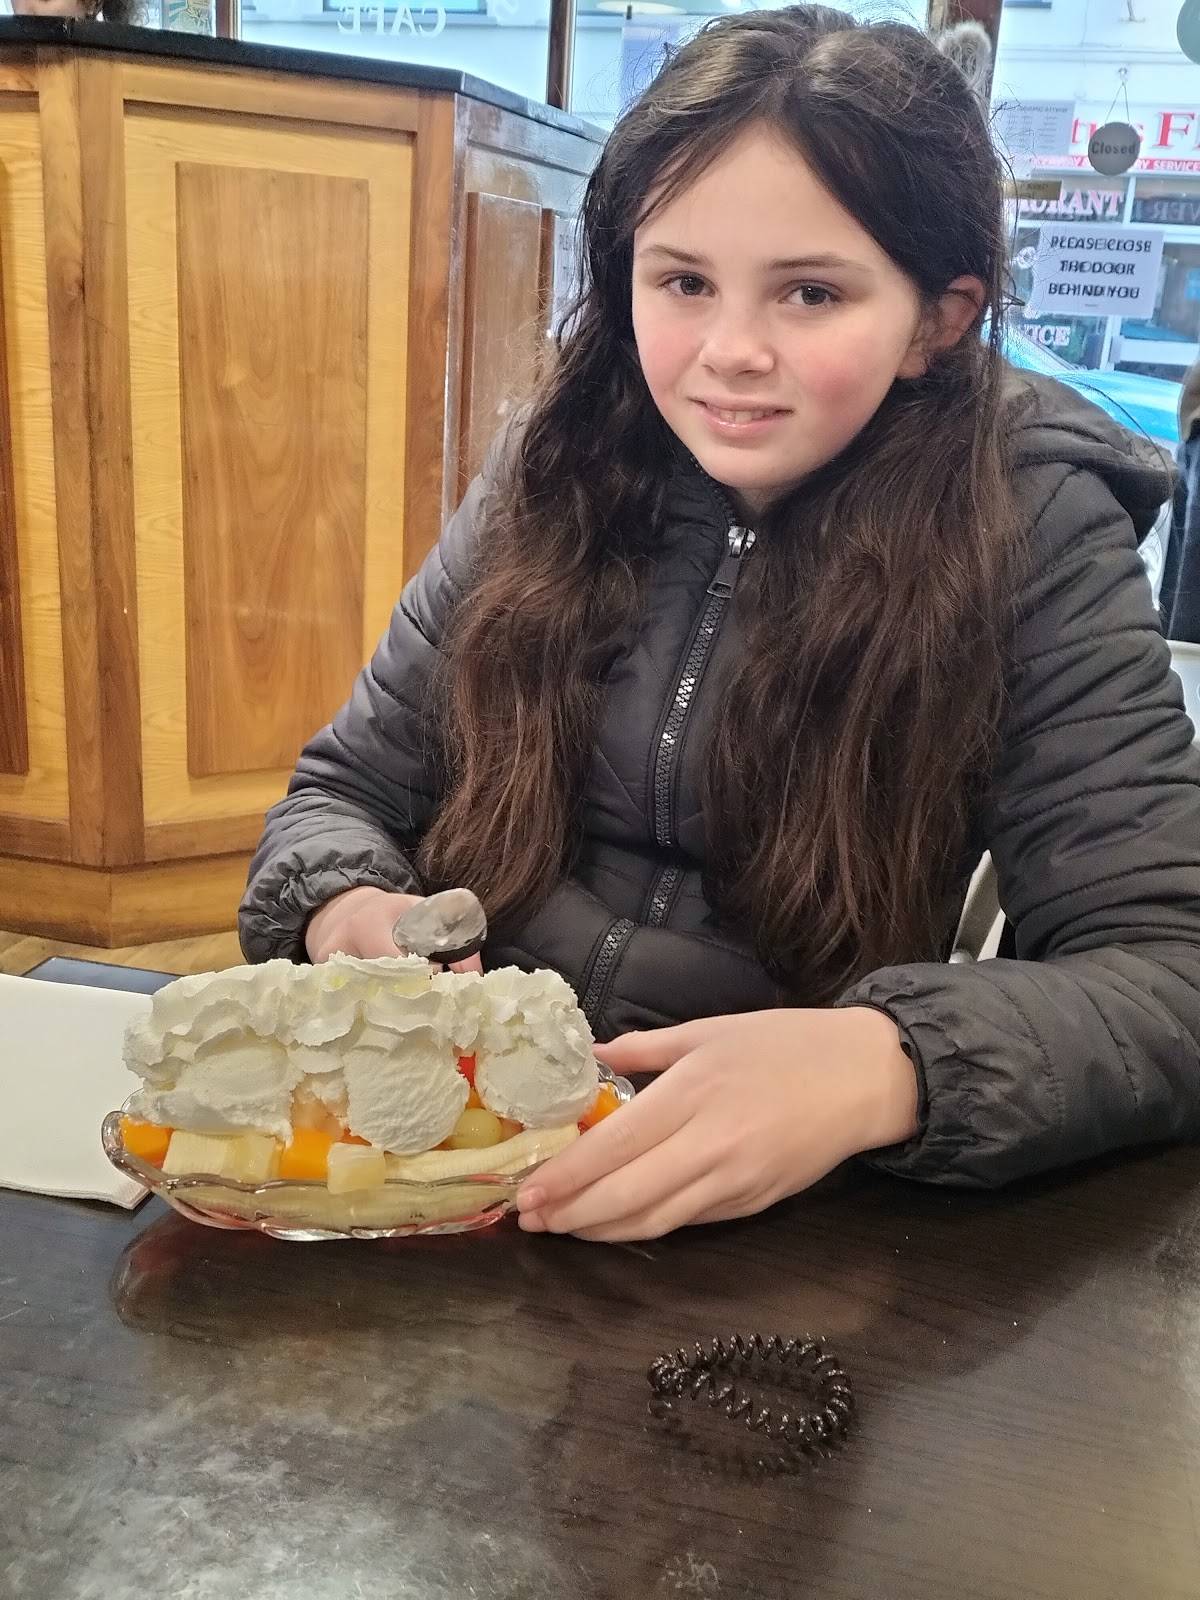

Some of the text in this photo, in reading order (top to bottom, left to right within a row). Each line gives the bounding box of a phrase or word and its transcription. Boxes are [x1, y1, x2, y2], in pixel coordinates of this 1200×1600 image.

[1091, 141, 1136, 154] Closed
[1050, 236, 1152, 253] PLEASE CLOSE
[1060, 260, 1136, 275] THE DOOR
[1048, 283, 1140, 299] BEHIND YOU
